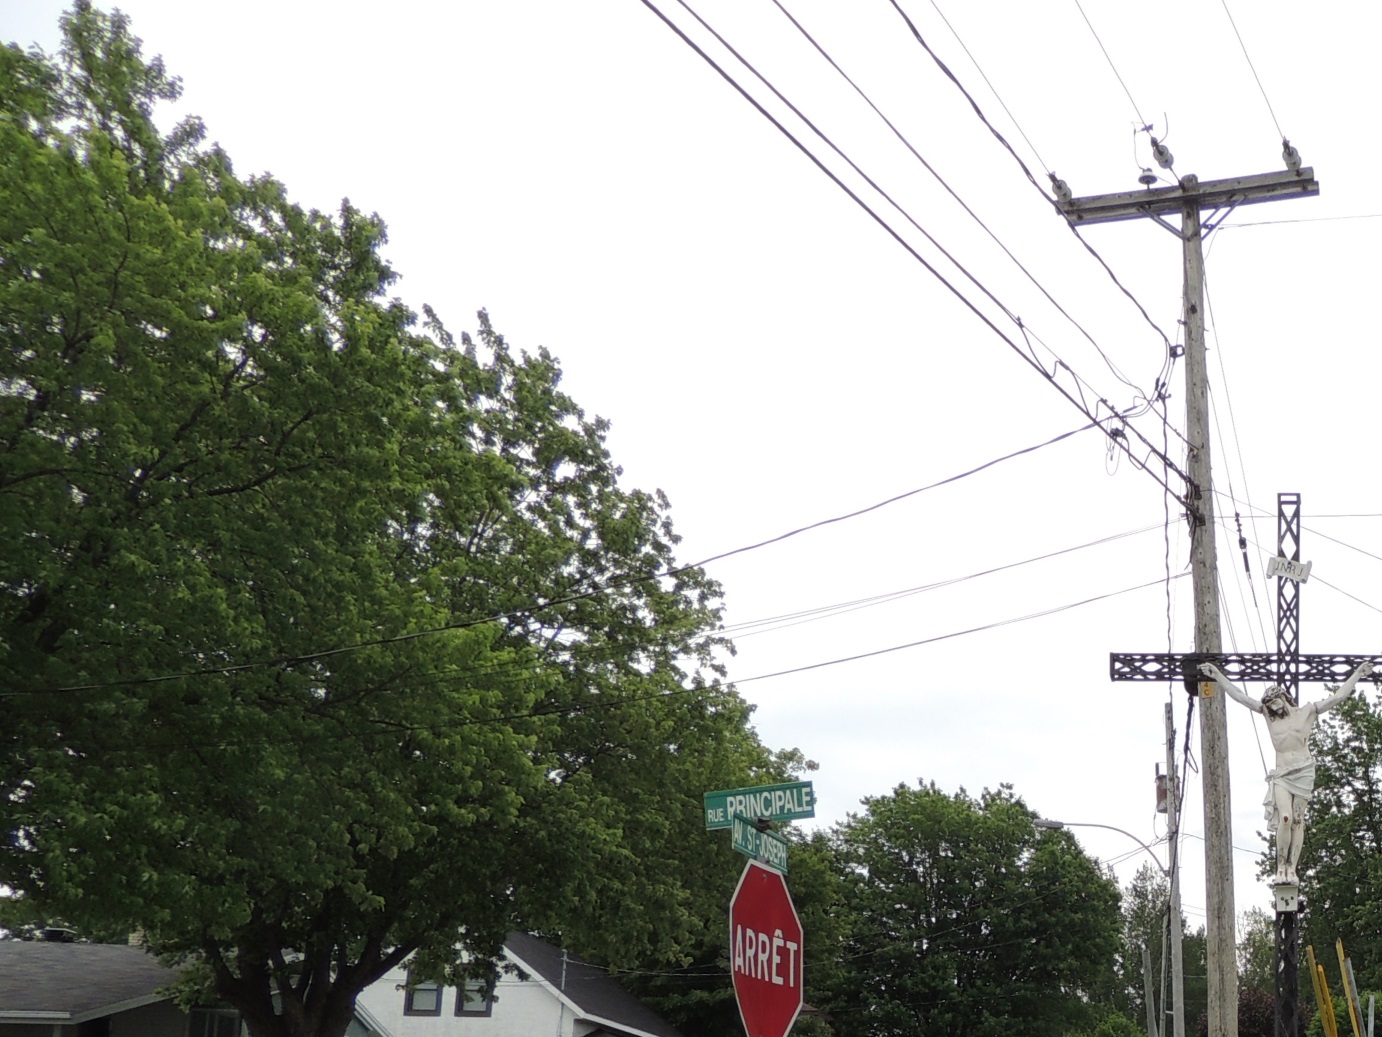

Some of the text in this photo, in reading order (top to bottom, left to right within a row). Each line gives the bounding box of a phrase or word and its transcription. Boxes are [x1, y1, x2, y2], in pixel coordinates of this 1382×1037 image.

[707, 787, 812, 823] RUE PRINCIPALE
[733, 818, 787, 868] AV. ST-JOSEPH
[734, 924, 798, 988] ARRÊT
